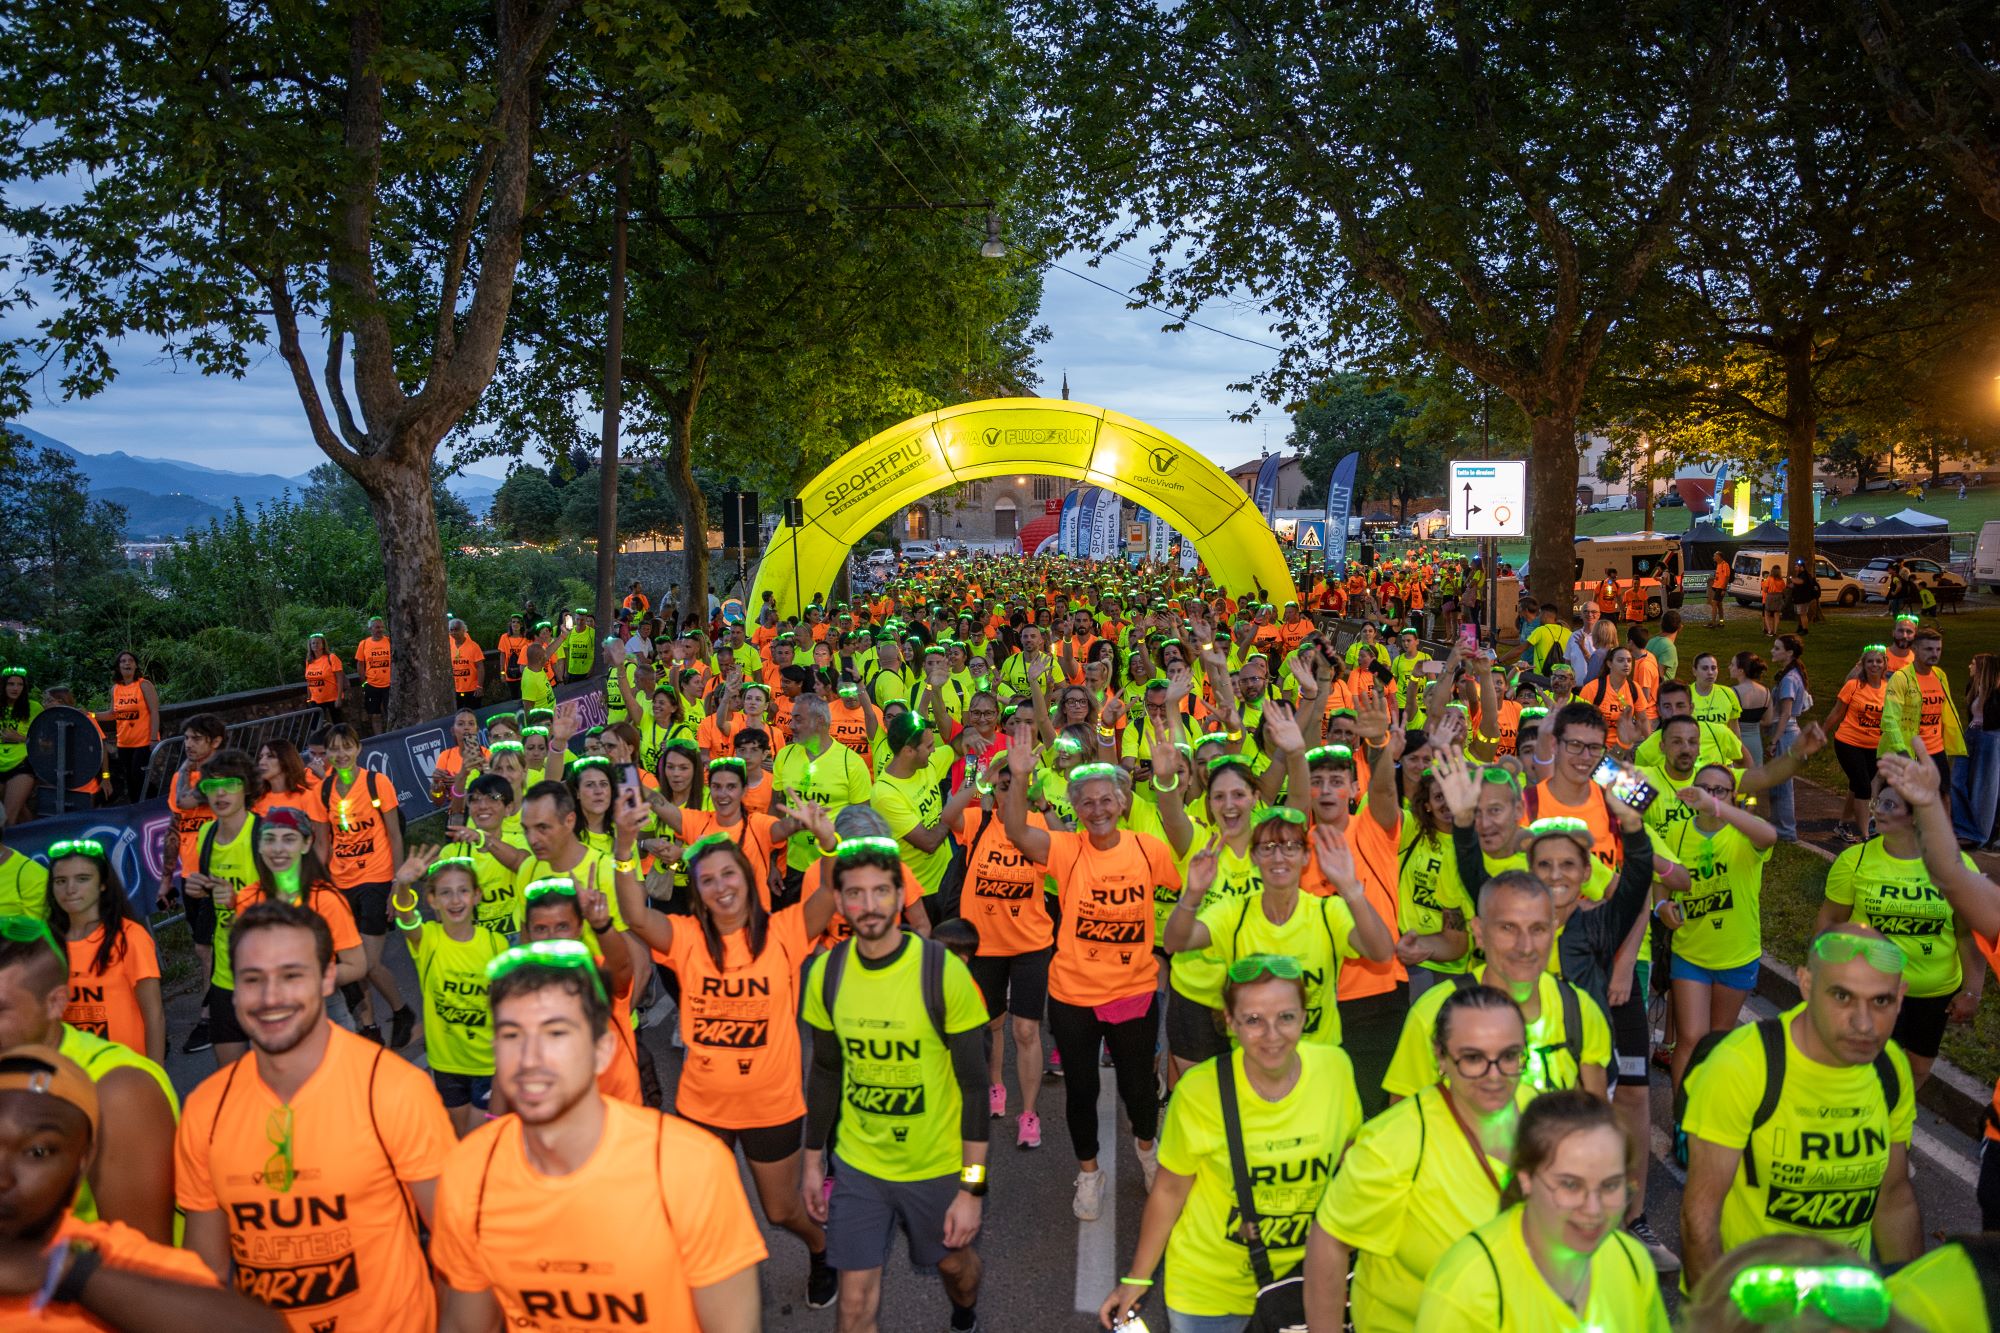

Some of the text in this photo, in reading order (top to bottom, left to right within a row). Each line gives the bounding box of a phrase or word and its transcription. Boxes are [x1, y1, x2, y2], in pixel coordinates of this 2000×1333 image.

[480, 885, 515, 904] UN
[976, 880, 1032, 898] PARTY
[1091, 884, 1144, 906] RUN
[1865, 897, 1882, 905] FOR
[1077, 919, 1144, 941] PARTY
[1871, 915, 1944, 934] PARTY
[702, 976, 770, 998] RUN
[693, 1018, 767, 1045] PARTY
[845, 1037, 921, 1062] RUN
[847, 1083, 923, 1112] PARTY
[1800, 1127, 1887, 1161] RUN
[1249, 1152, 1333, 1187] RUN
[1771, 1161, 1806, 1174] FOR
[1771, 1171, 1805, 1185] THE
[231, 1194, 348, 1231] RUN
[253, 1226, 352, 1262] AFTER
[238, 1257, 352, 1305] PARTY
[519, 1289, 648, 1325] RUN
